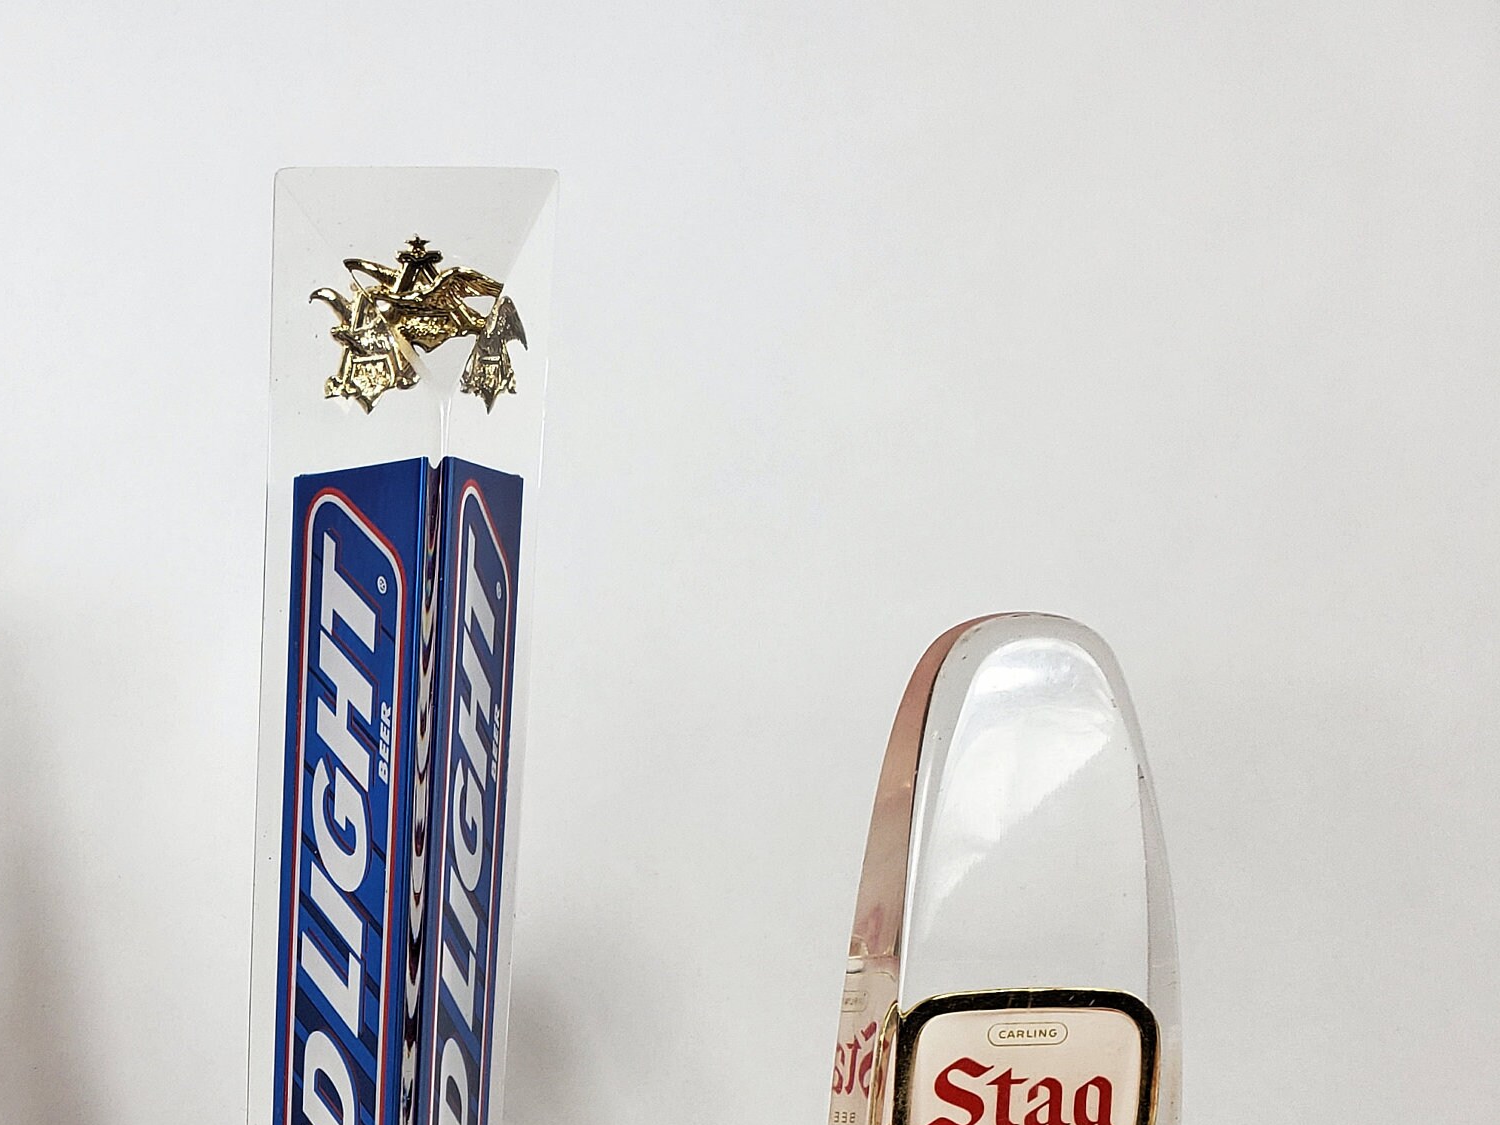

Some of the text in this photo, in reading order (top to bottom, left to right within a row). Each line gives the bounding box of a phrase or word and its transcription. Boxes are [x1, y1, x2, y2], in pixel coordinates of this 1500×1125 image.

[301, 529, 381, 1038] LIGHT
[376, 700, 393, 786] BEER
[441, 524, 497, 1034] LIGHT
[997, 1028, 1058, 1039] CARLING
